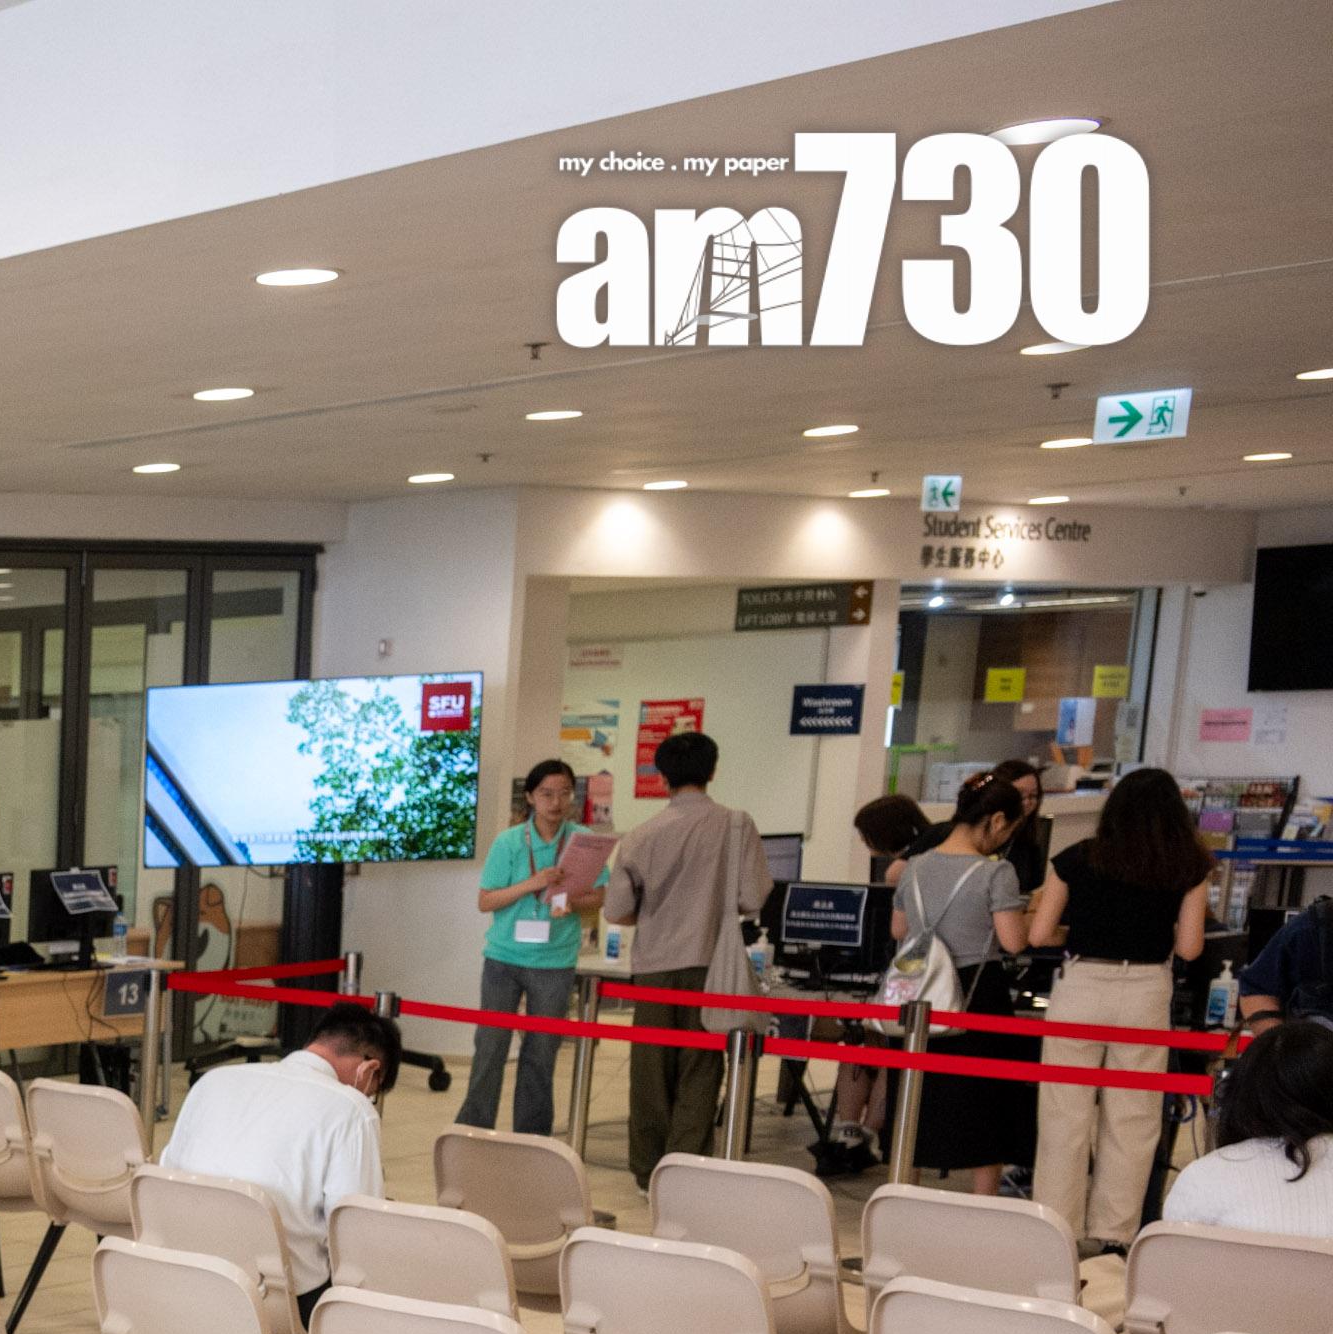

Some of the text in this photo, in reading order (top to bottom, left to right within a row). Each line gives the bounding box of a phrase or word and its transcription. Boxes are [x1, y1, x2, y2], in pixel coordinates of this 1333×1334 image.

[923, 512, 1092, 542] Student Services Centre
[428, 694, 465, 710] SFU
[119, 983, 139, 1005] 13
